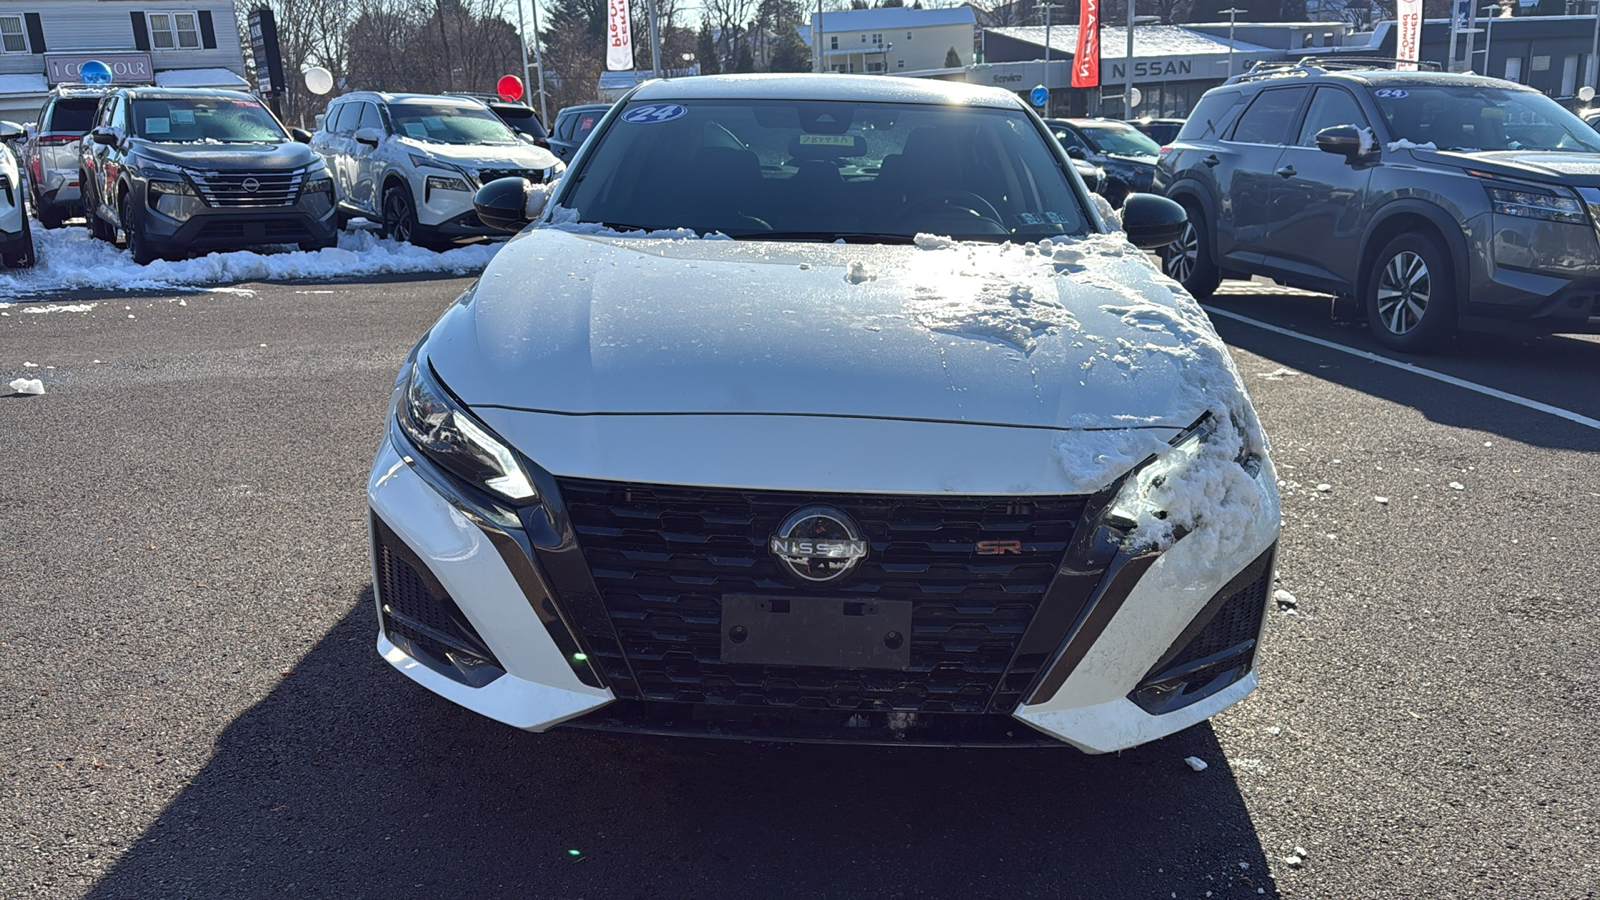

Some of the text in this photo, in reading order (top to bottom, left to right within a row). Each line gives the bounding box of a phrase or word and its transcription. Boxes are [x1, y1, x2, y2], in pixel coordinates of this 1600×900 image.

[1113, 61, 1192, 78] NSSAN
[993, 73, 1022, 83] Service
[1379, 89, 1402, 98] 24
[628, 105, 680, 121] 24
[774, 539, 864, 555] NISSAN
[977, 540, 1022, 555] SR
